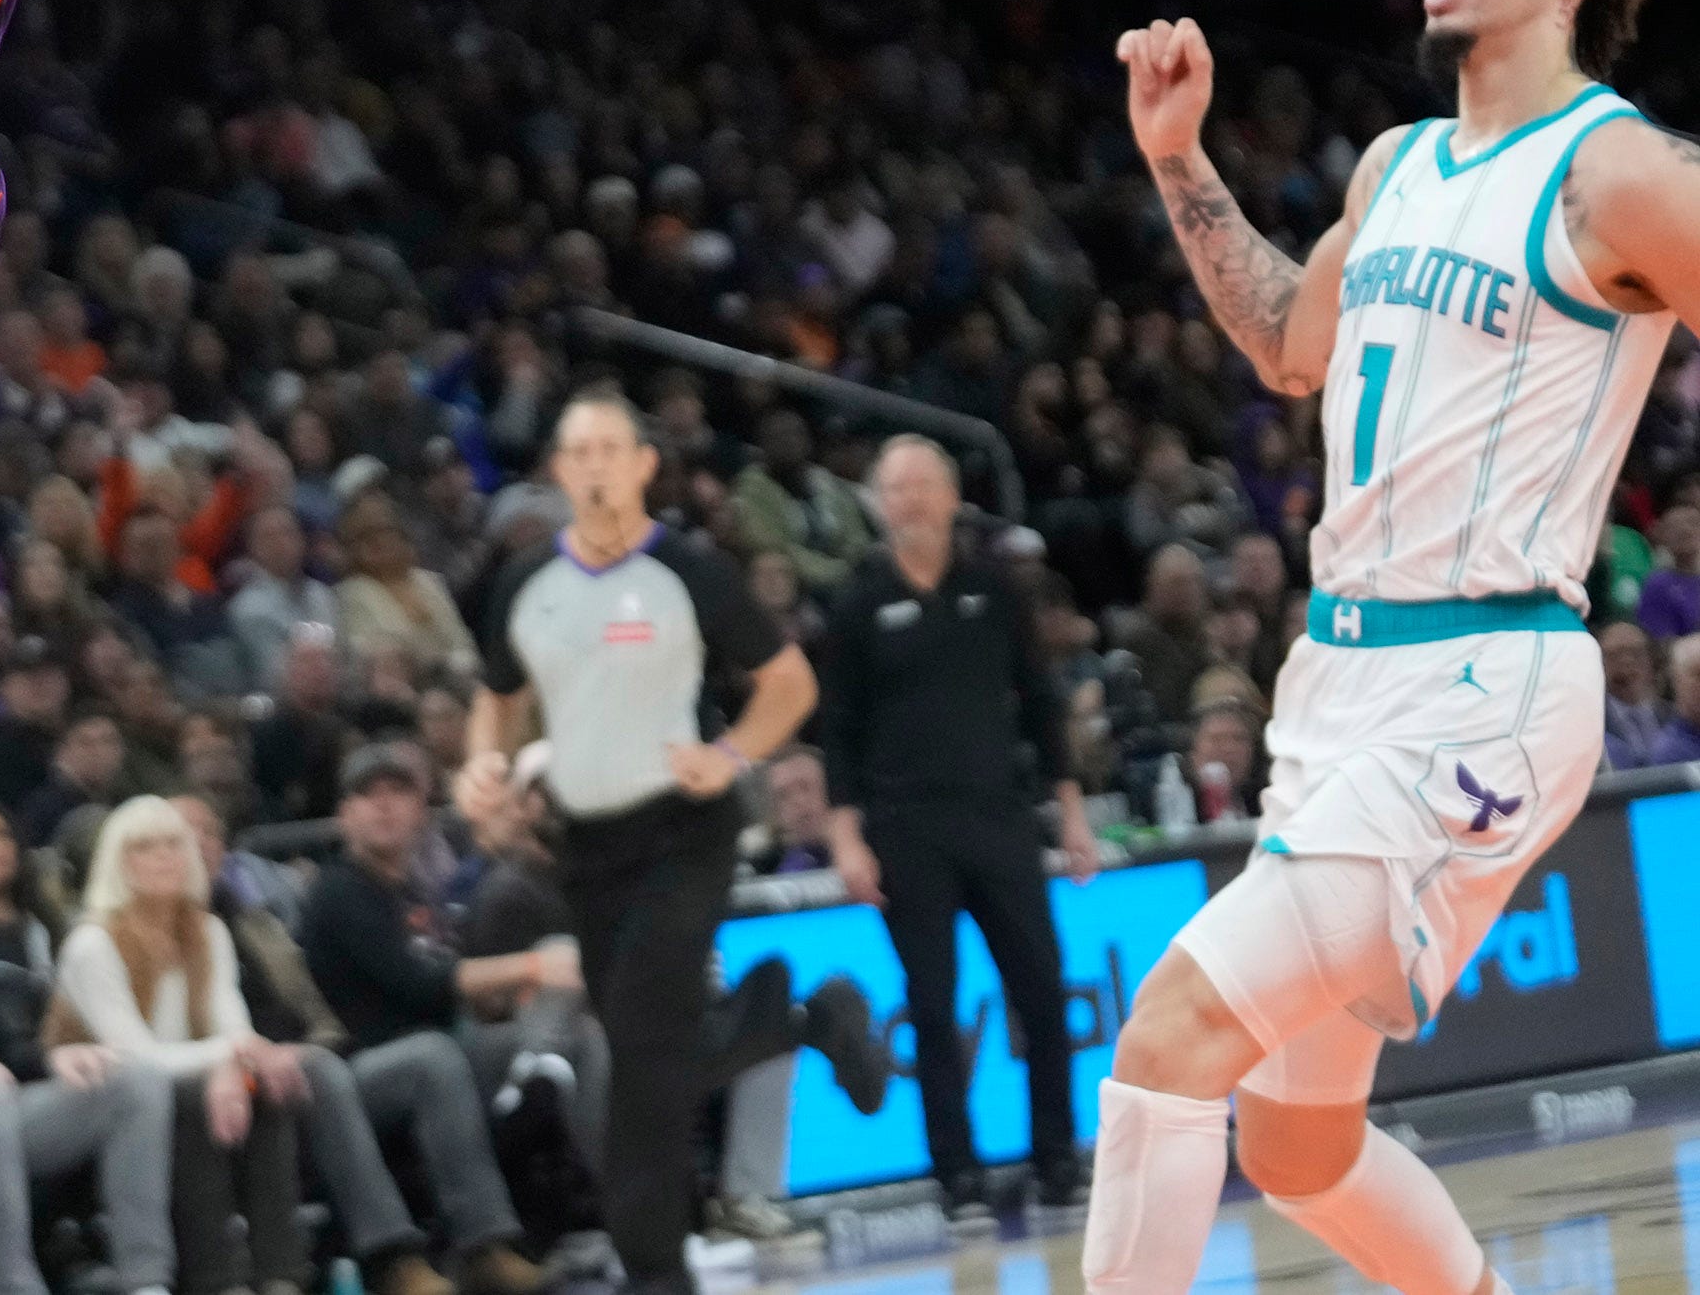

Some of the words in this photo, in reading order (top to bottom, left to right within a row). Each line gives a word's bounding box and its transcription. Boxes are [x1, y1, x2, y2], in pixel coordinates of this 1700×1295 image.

[1340, 245, 1515, 339] HARLOTTE
[1350, 341, 1396, 486] 1
[1333, 603, 1362, 641] H
